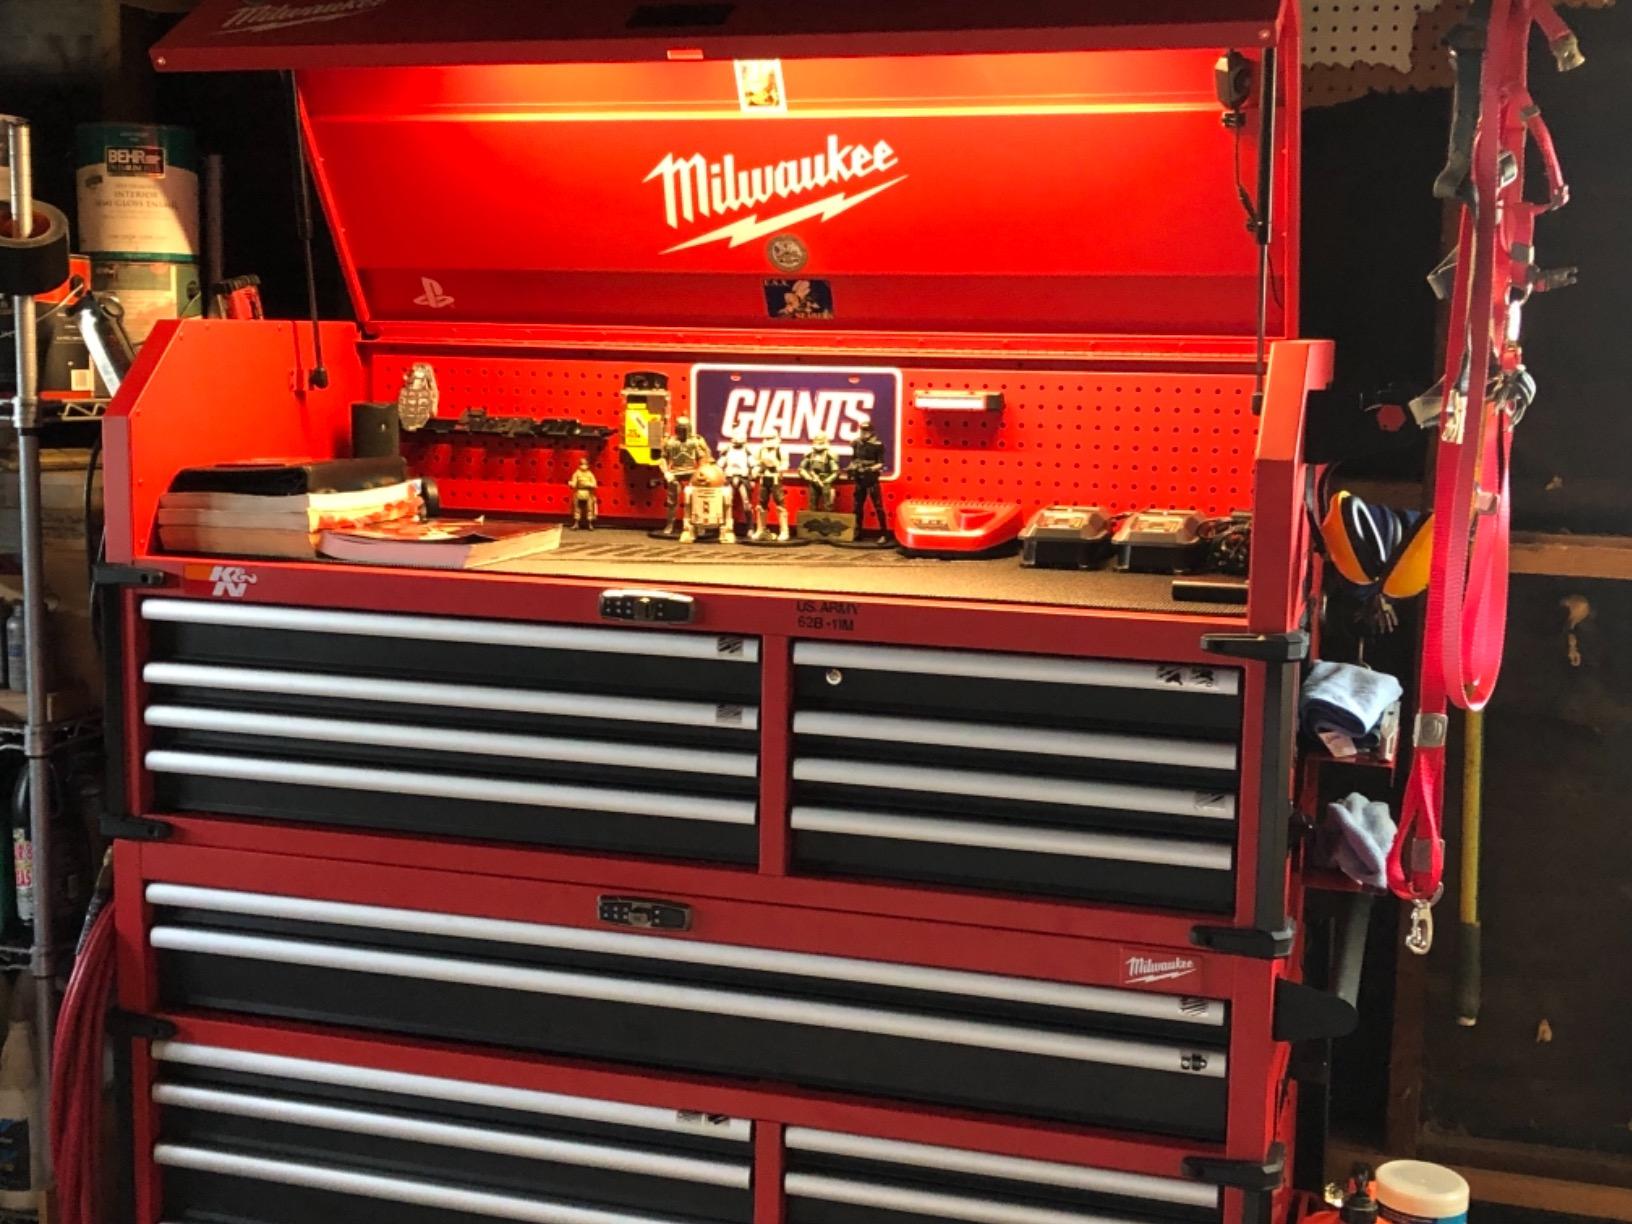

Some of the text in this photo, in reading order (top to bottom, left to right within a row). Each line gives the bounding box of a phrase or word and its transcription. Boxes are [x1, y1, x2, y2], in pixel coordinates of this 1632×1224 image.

[108, 149, 146, 164] BEHR
[642, 134, 899, 229] Milwaukee
[721, 388, 875, 442] GIANTS
[1125, 957, 1195, 977] Milwaukee
